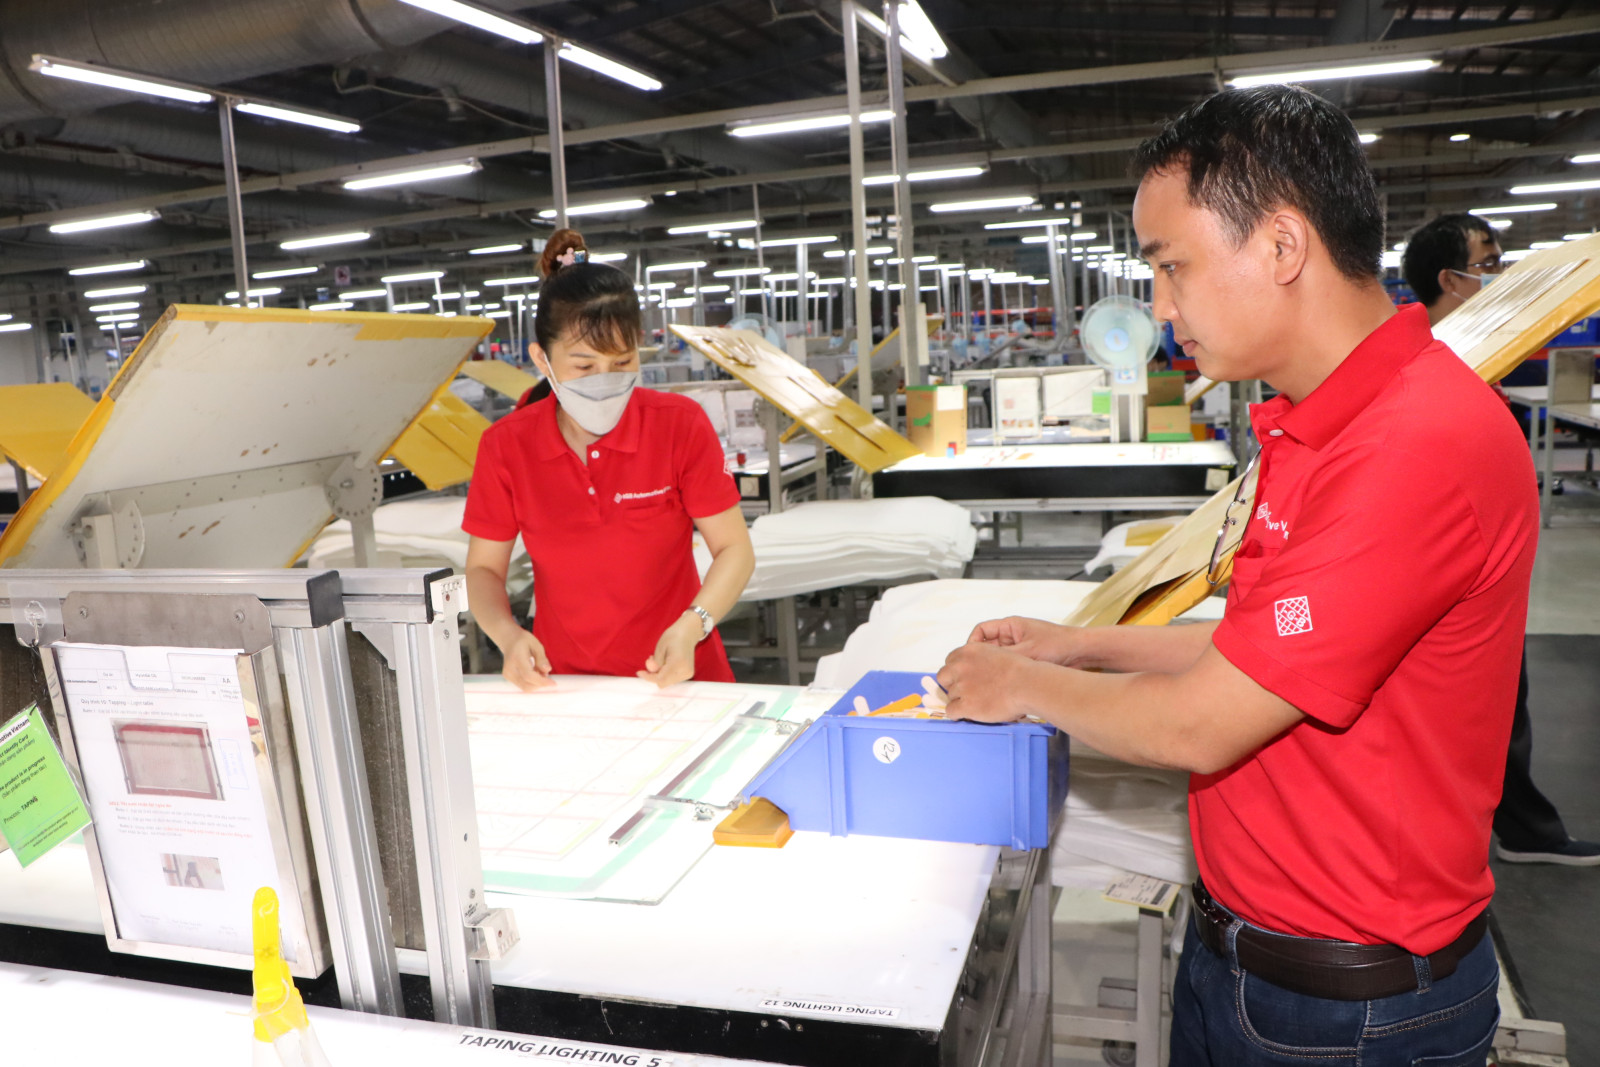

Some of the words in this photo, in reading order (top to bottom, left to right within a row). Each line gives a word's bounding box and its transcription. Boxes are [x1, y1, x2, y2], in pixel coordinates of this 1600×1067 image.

[20, 795, 38, 811] TAPING
[783, 1001, 842, 1013] LIGHTING
[845, 1006, 894, 1017] TAPING
[458, 1034, 536, 1053] TAPING
[538, 1044, 640, 1066] LIGHTING
[647, 1057, 663, 1067] 5
